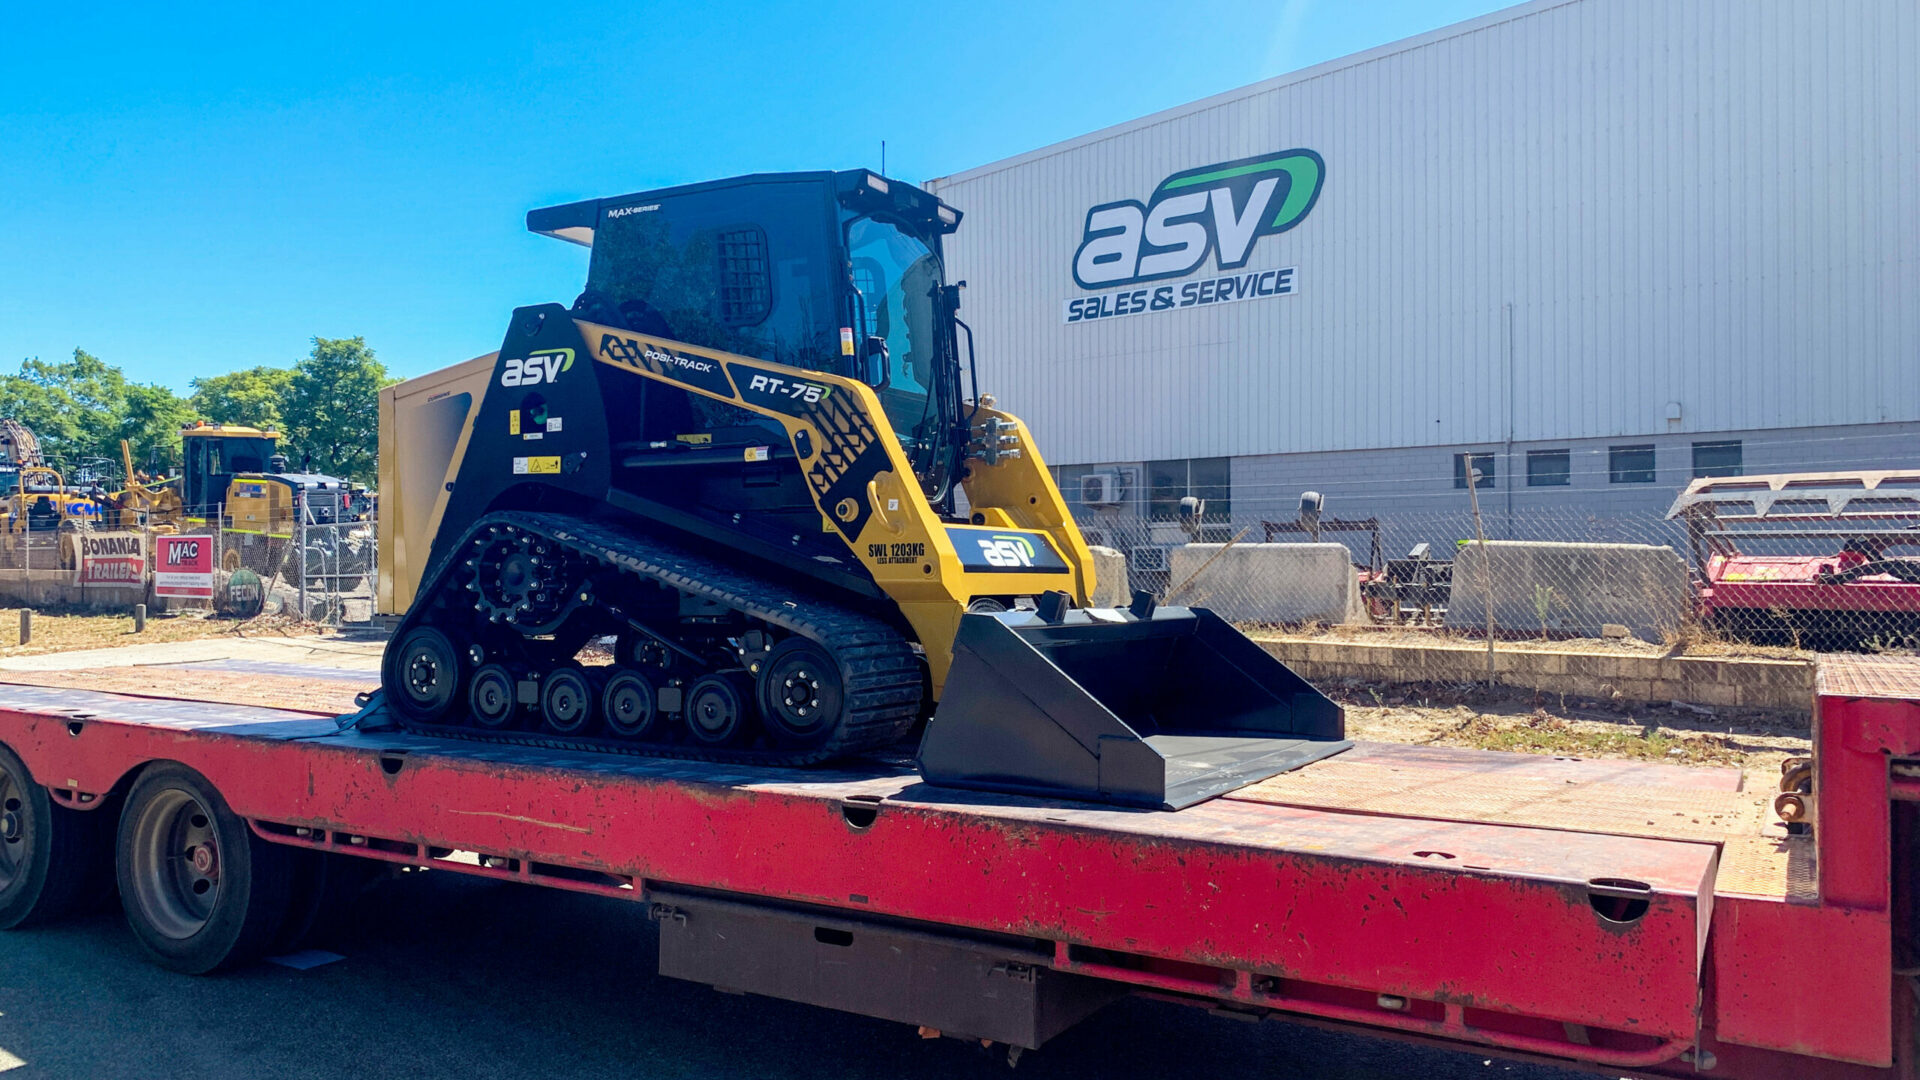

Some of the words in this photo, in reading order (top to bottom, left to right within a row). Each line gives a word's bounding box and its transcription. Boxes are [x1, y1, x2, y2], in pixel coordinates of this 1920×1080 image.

[1150, 287, 1177, 311] &
[1180, 268, 1294, 306] SERVICE
[644, 350, 713, 373] POSI-TRACK
[749, 374, 822, 403] RT-75
[167, 541, 199, 566] MAC
[868, 543, 888, 557] SWL
[890, 543, 925, 557] 1203KG
